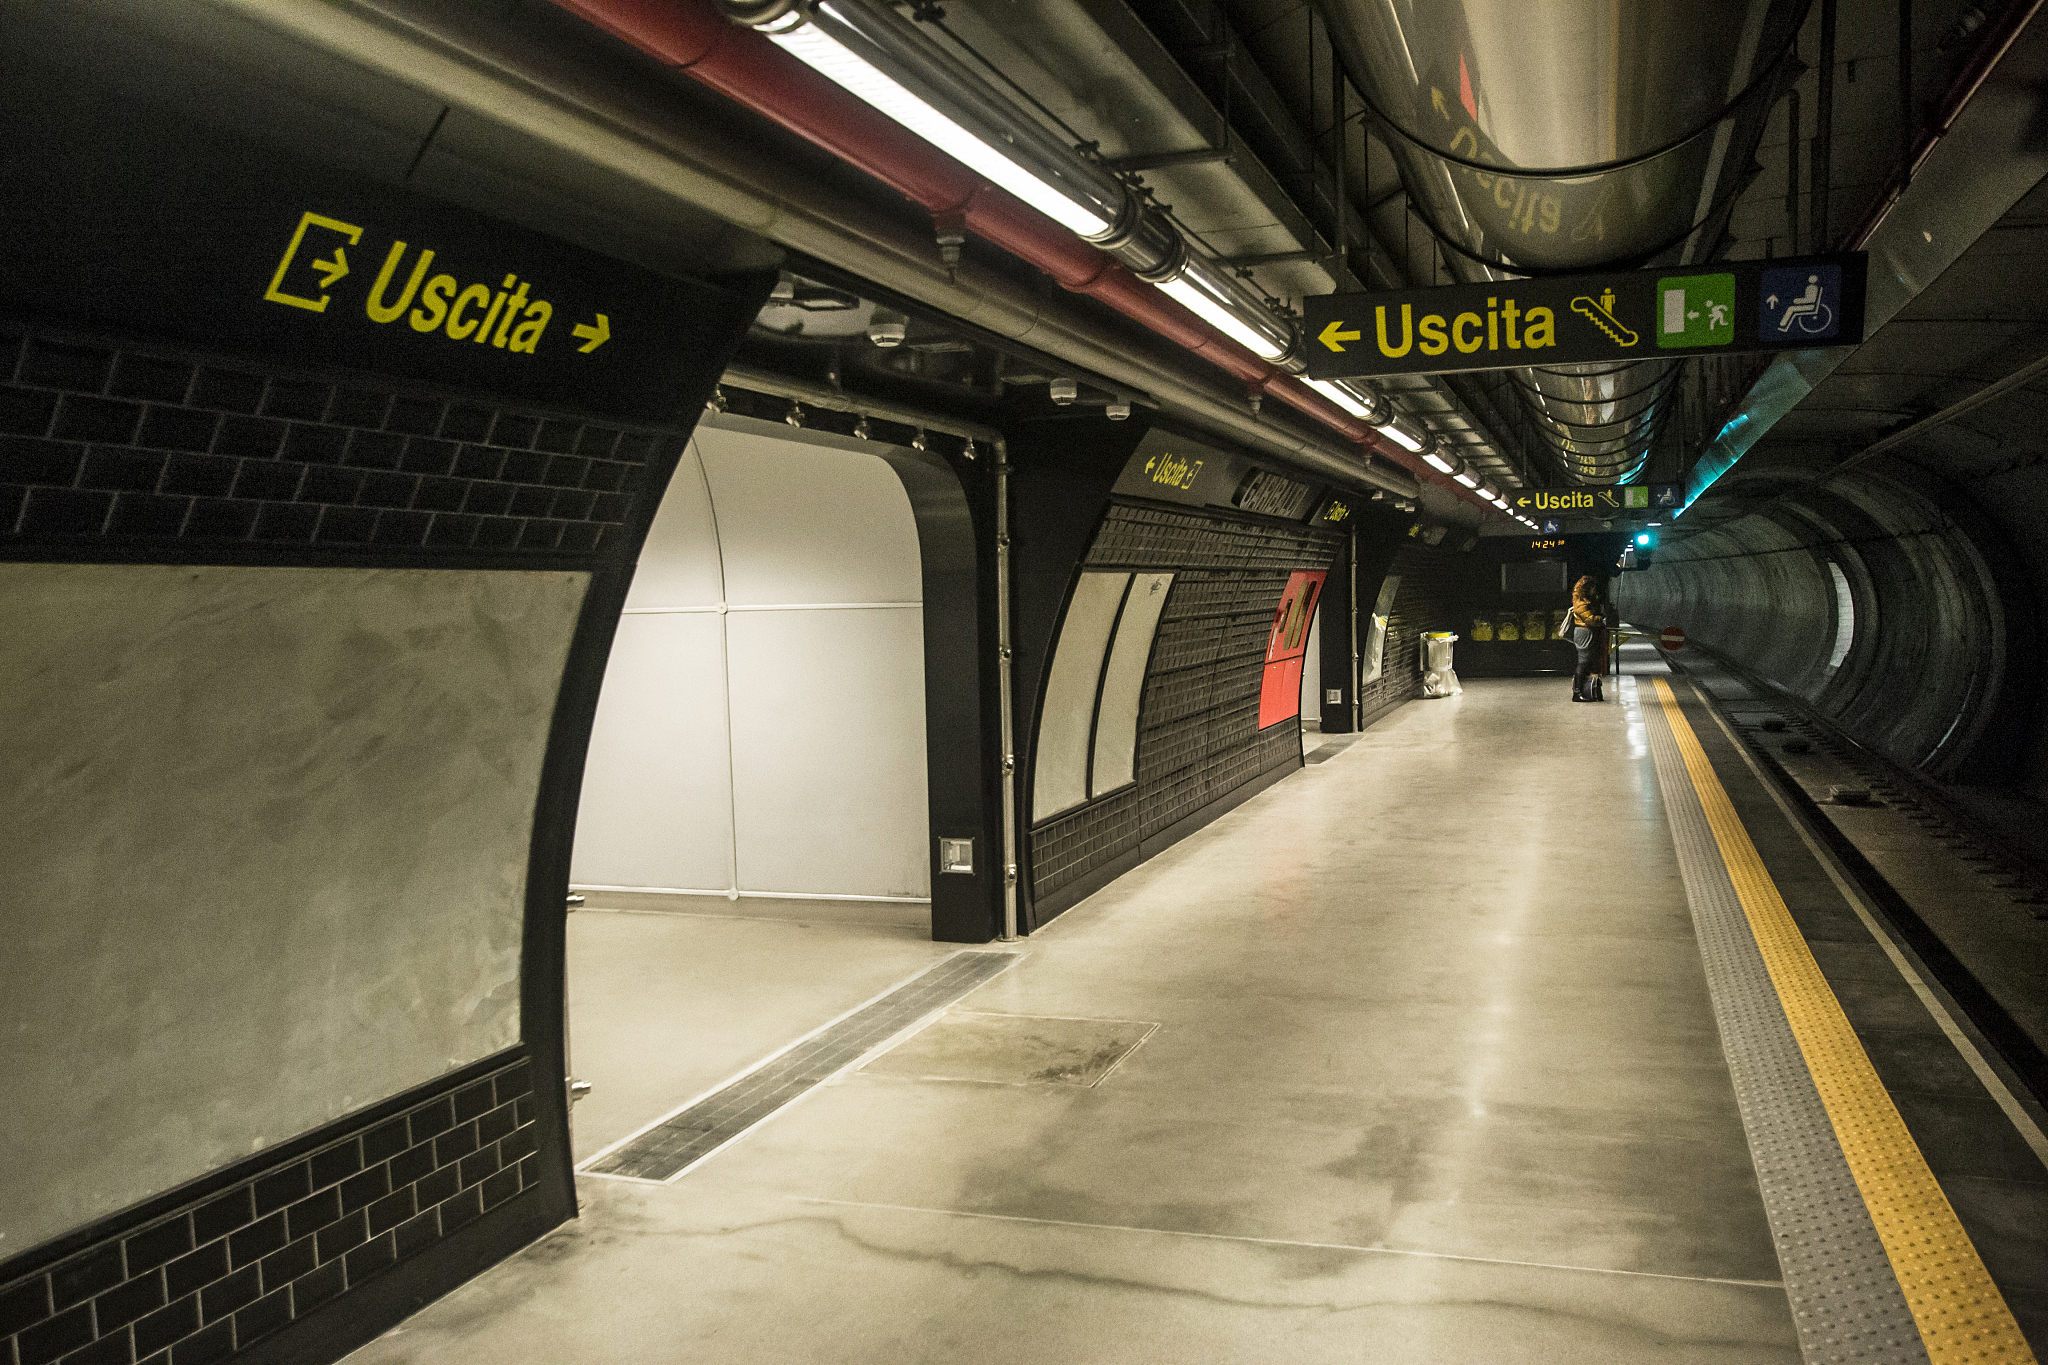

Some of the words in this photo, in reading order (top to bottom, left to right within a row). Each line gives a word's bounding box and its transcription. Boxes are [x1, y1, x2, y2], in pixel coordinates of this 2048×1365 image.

[365, 240, 553, 355] Uscita
[1375, 296, 1557, 359] Uscita
[1152, 453, 1188, 486] Uscita
[1240, 471, 1311, 518] GARIBALDI
[1535, 491, 1594, 510] Uscita
